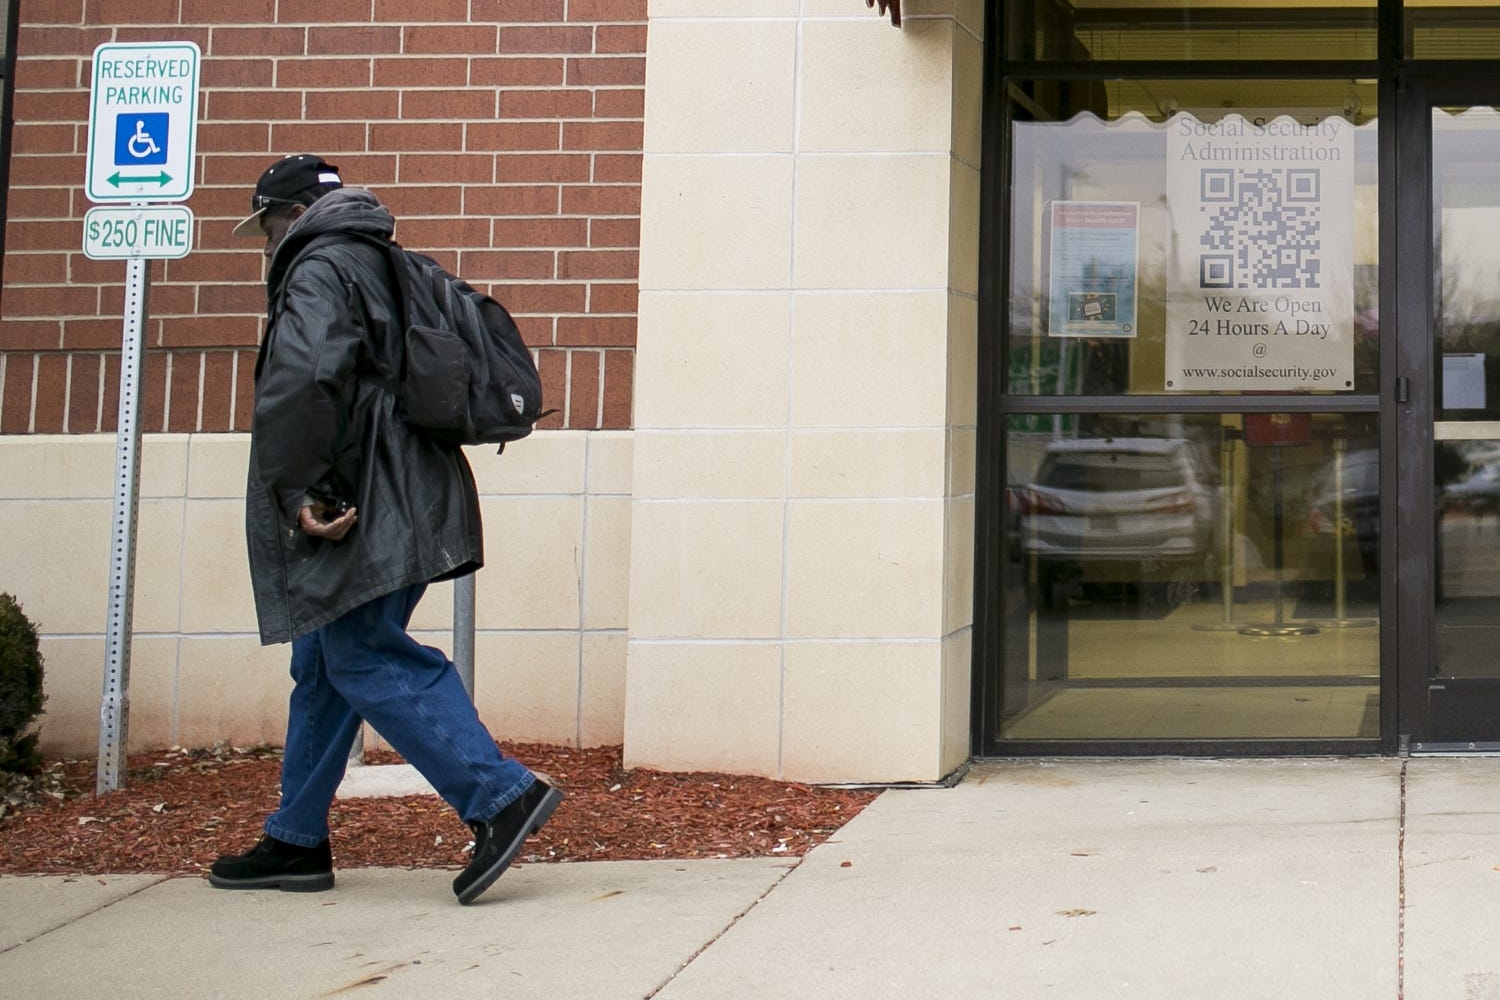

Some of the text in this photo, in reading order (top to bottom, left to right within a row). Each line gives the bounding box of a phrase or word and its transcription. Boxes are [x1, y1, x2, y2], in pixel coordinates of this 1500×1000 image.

[101, 58, 191, 79] RESERVED
[105, 85, 183, 105] PARKING
[1179, 116, 1341, 142] Social Security
[1180, 141, 1343, 161] Administration
[89, 218, 186, 248] $250 FINE
[1204, 296, 1322, 317] We Are Open
[1188, 319, 1332, 340] 24 Hours A Day
[1252, 342, 1267, 358] @
[1183, 365, 1337, 381] www.socialsecurity.gov
